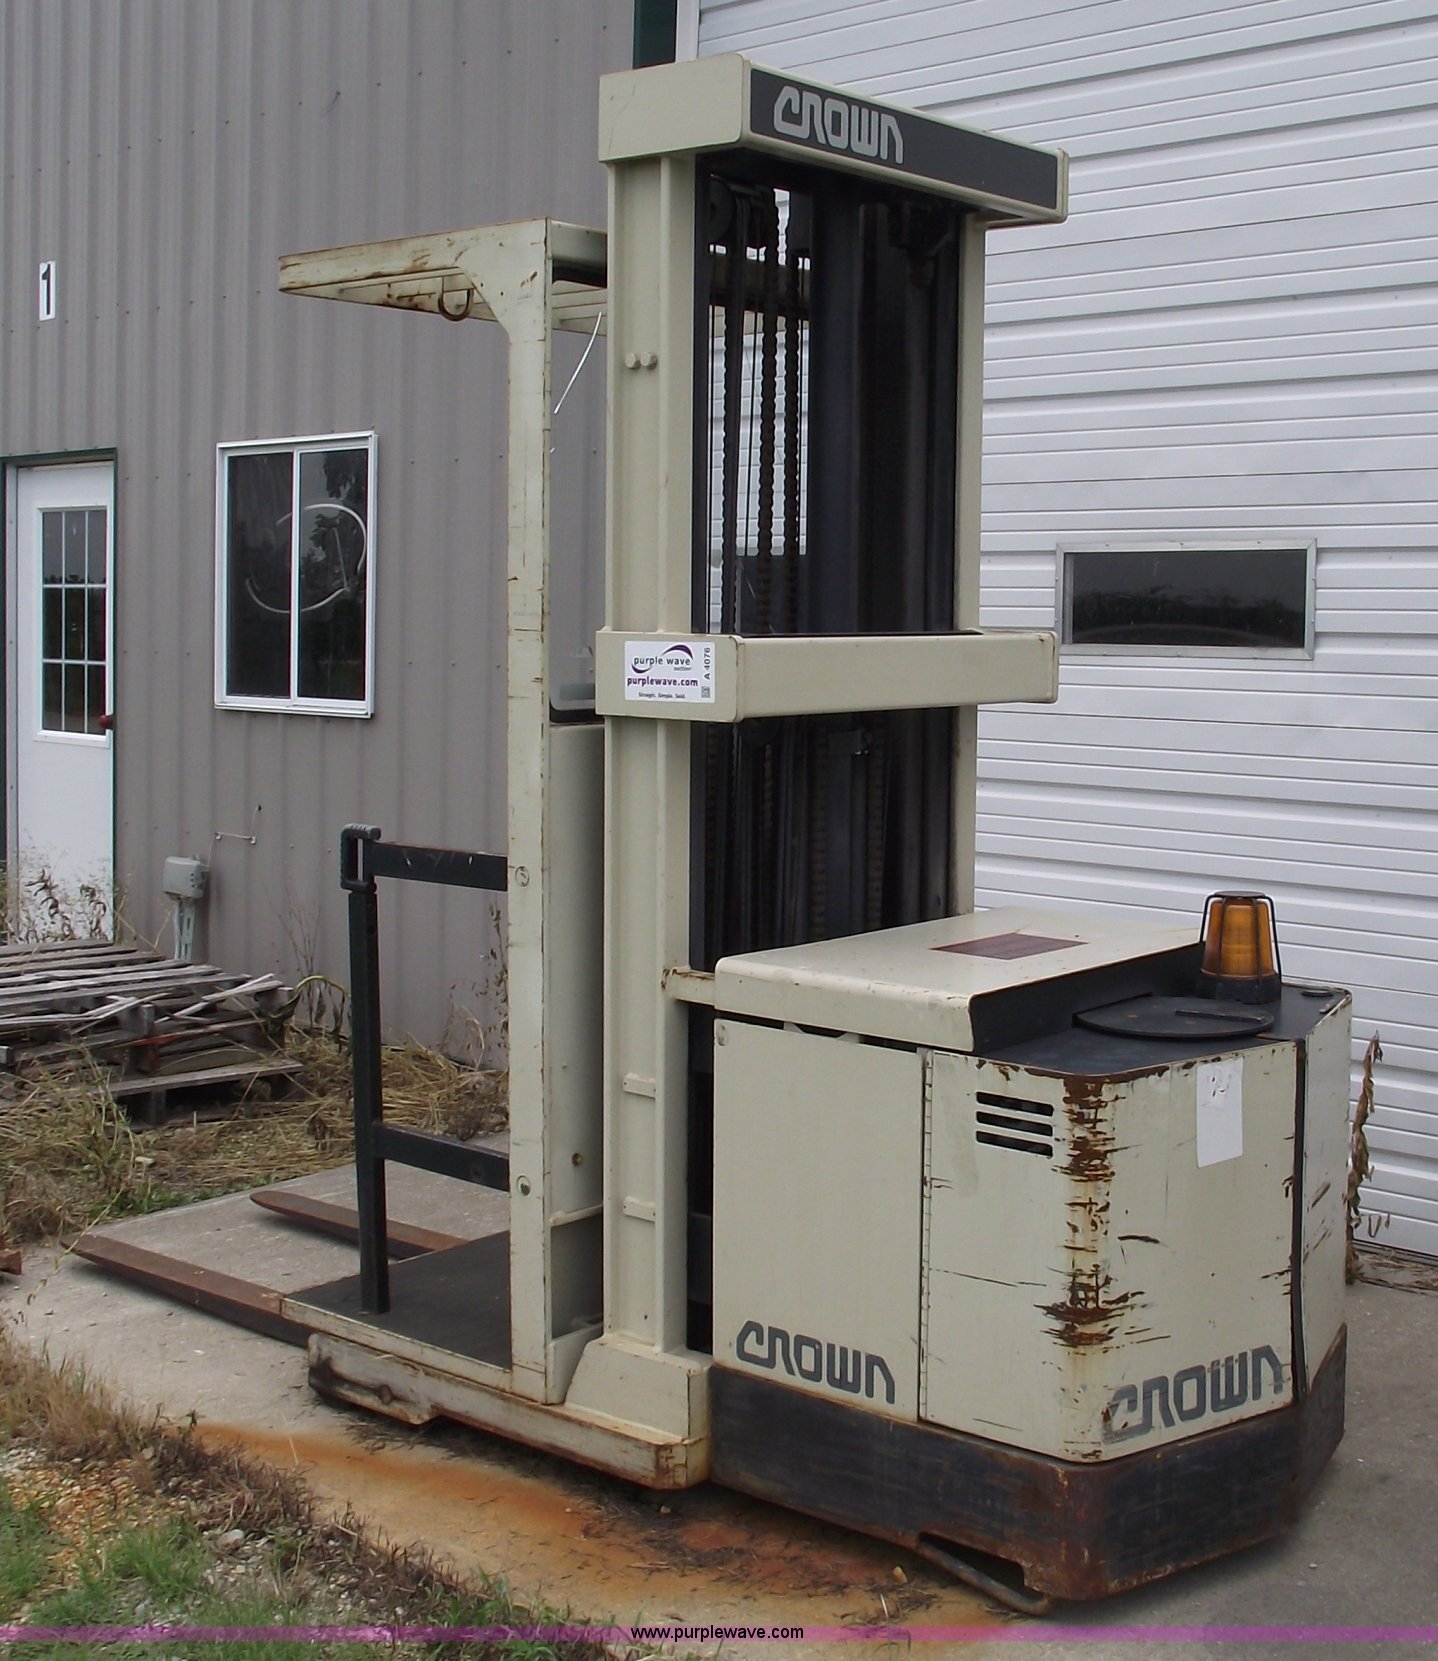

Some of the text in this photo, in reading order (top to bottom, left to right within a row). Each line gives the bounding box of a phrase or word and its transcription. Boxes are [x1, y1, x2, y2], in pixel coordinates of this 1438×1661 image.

[773, 85, 904, 165] CROWN
[41, 262, 51, 316] 1
[627, 676, 698, 687] purplewave.com
[634, 656, 691, 666] purple wave
[736, 1320, 895, 1405] CROWN
[1103, 1344, 1284, 1444] CROWN
